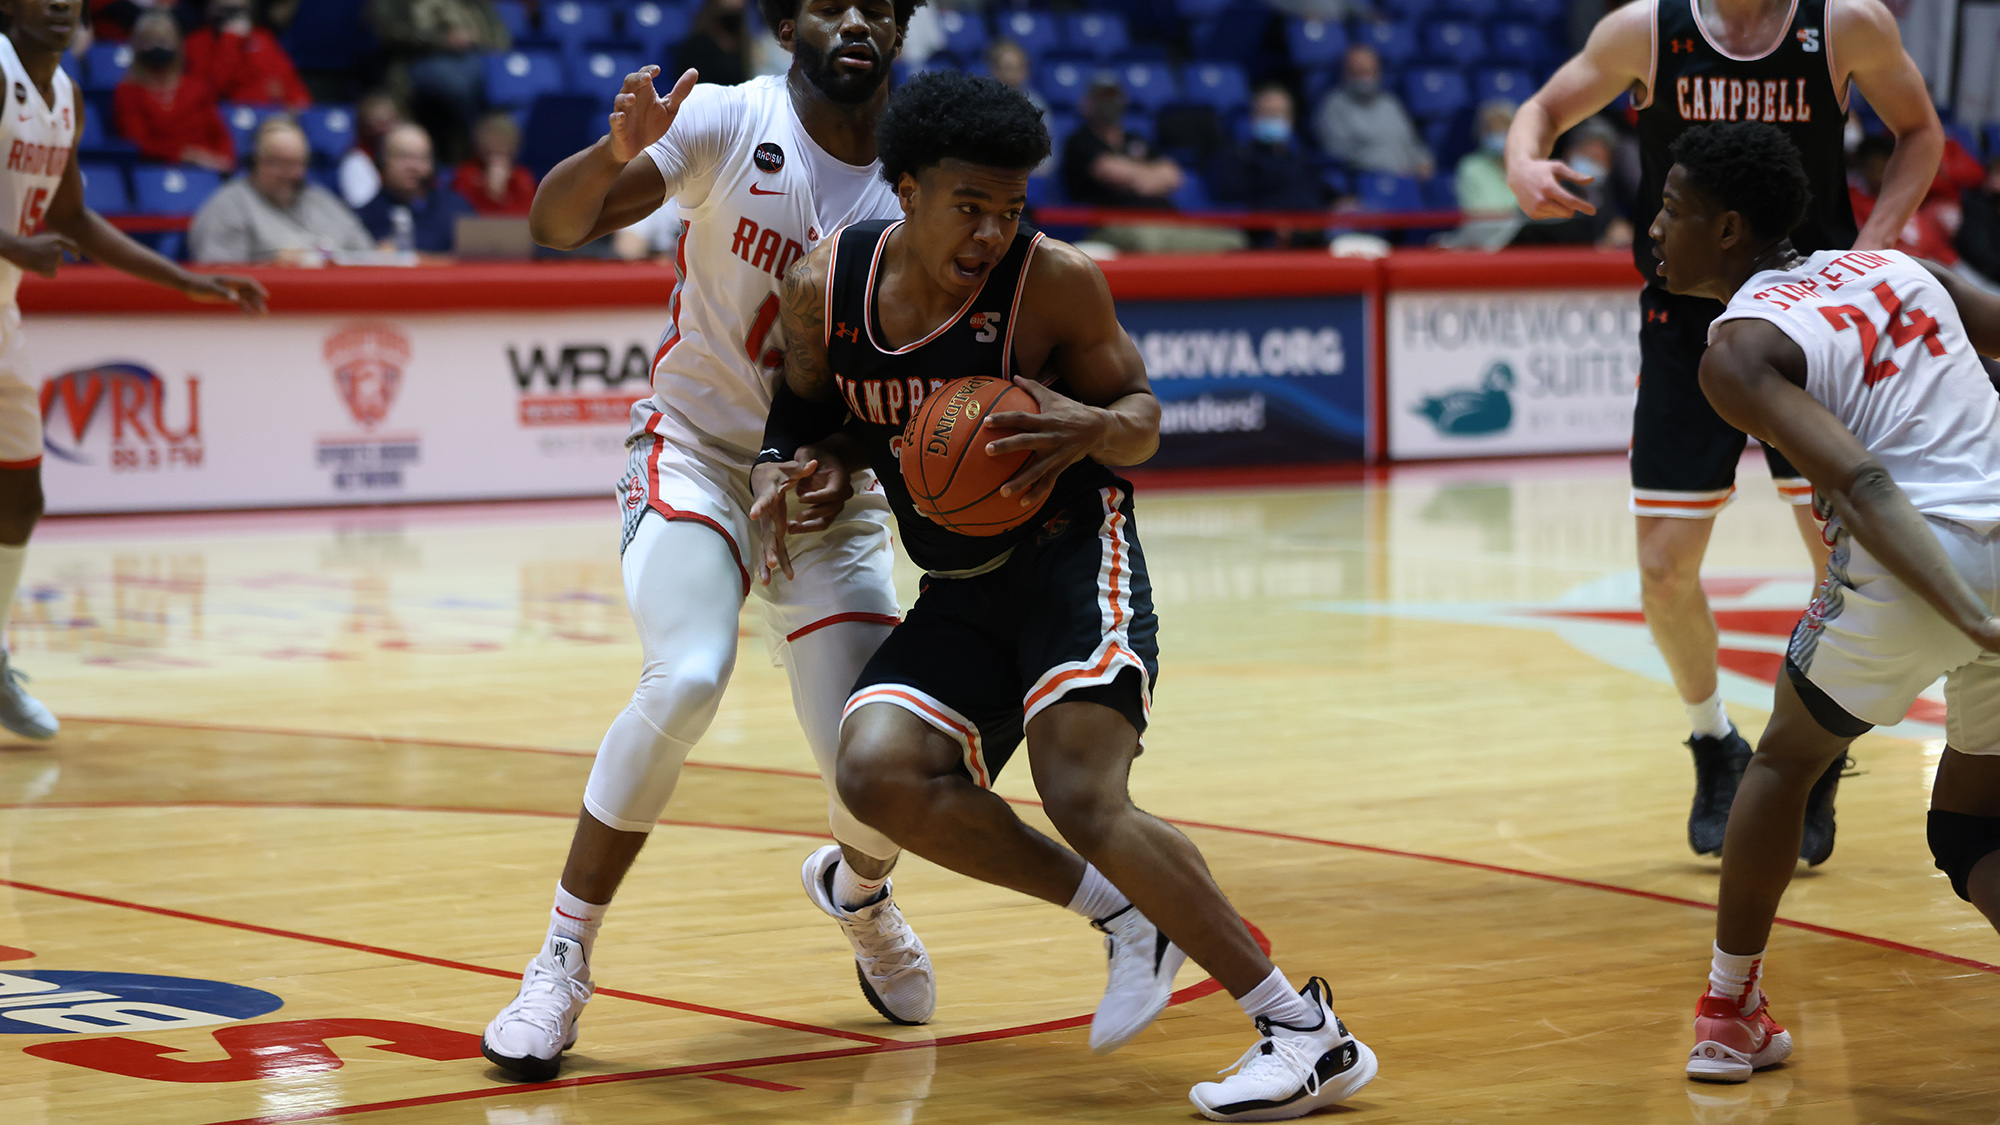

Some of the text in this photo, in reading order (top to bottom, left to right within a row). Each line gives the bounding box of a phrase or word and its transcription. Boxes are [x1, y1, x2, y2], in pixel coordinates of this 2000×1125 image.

[1677, 75, 1811, 122] CAMPBELL
[7, 139, 71, 177] RADFOR
[756, 149, 783, 165] RACISM
[18, 186, 48, 238] 15
[731, 215, 806, 282] RAD
[970, 317, 986, 326] BIG
[1816, 279, 1952, 390] 24
[505, 343, 651, 388] WRA
[835, 372, 953, 426] CAMPB
[1159, 391, 1266, 434] anders!
